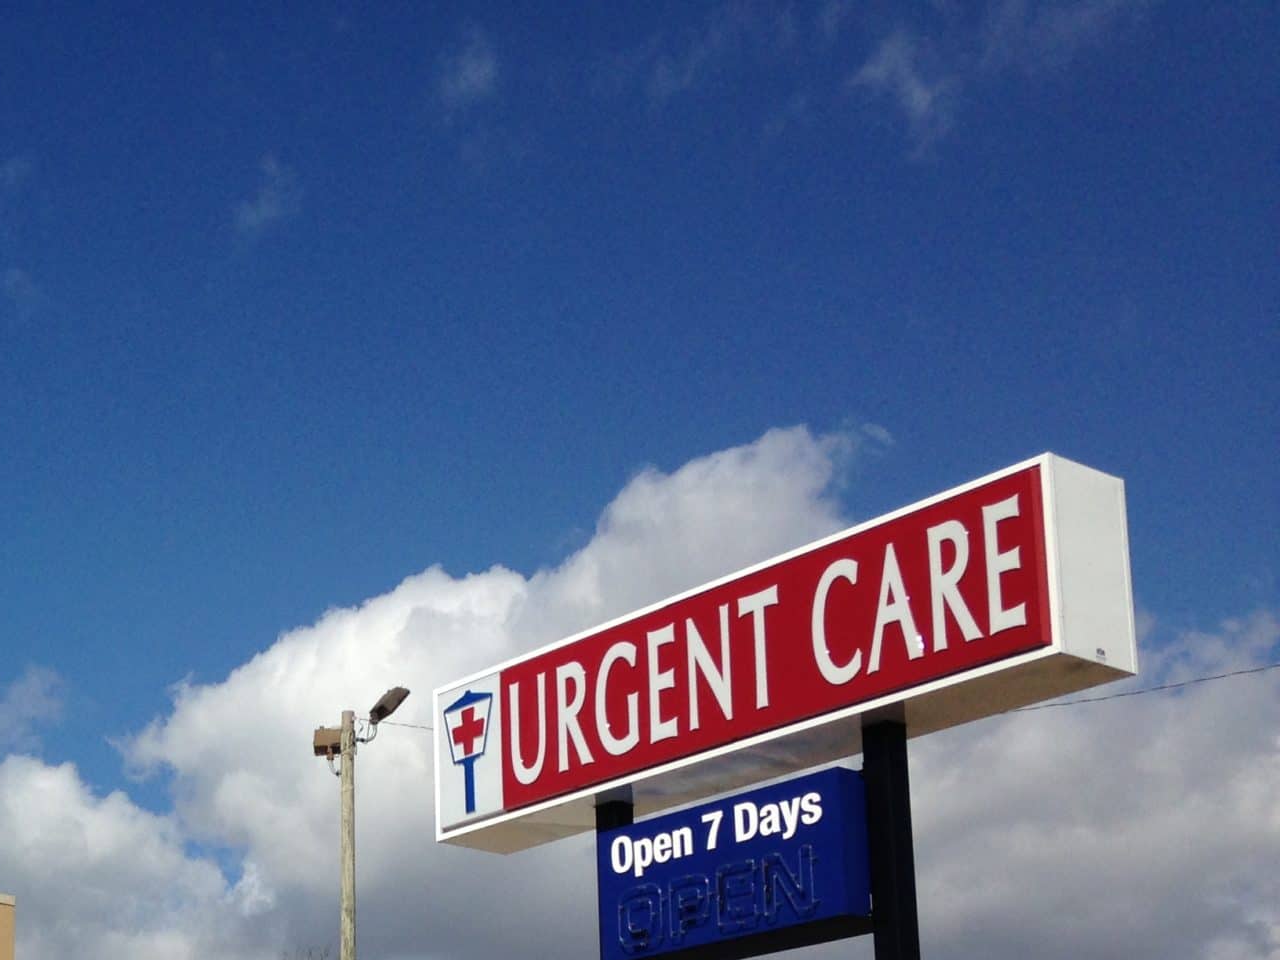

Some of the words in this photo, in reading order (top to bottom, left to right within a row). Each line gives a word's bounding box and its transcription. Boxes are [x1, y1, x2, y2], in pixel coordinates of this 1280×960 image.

[508, 584, 779, 785] URGENT
[811, 493, 1028, 686] CARE
[610, 825, 694, 877] Open
[701, 811, 724, 852] 7
[733, 792, 823, 843] Days
[618, 844, 820, 954] OPEN
